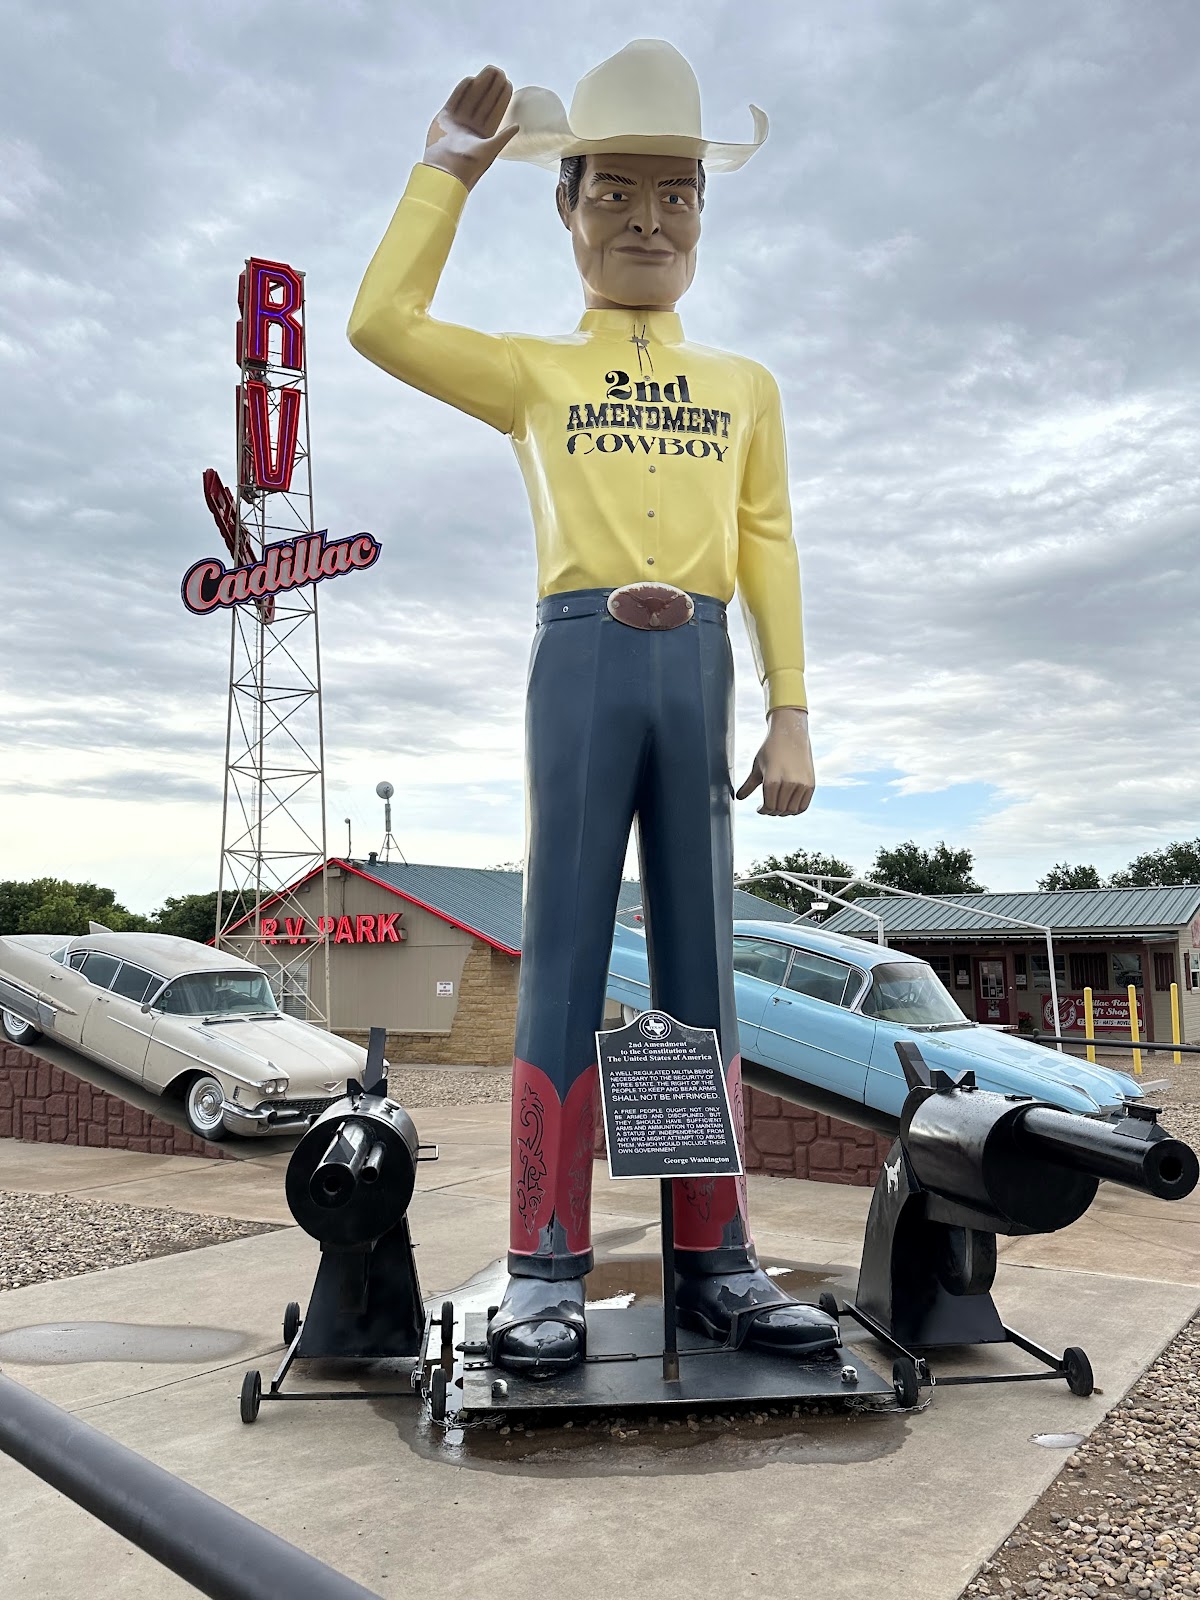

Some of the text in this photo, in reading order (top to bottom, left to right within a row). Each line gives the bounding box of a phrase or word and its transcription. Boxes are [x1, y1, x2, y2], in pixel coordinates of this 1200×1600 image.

[605, 370, 693, 403] 2nd
[566, 403, 731, 439] AMENDMENT
[566, 432, 729, 462] COWBOY
[184, 534, 378, 611] Cadillac
[318, 912, 403, 944] PARK
[1076, 999, 1141, 1007] Caillac Ranh
[1106, 1008, 1129, 1018] Shop
